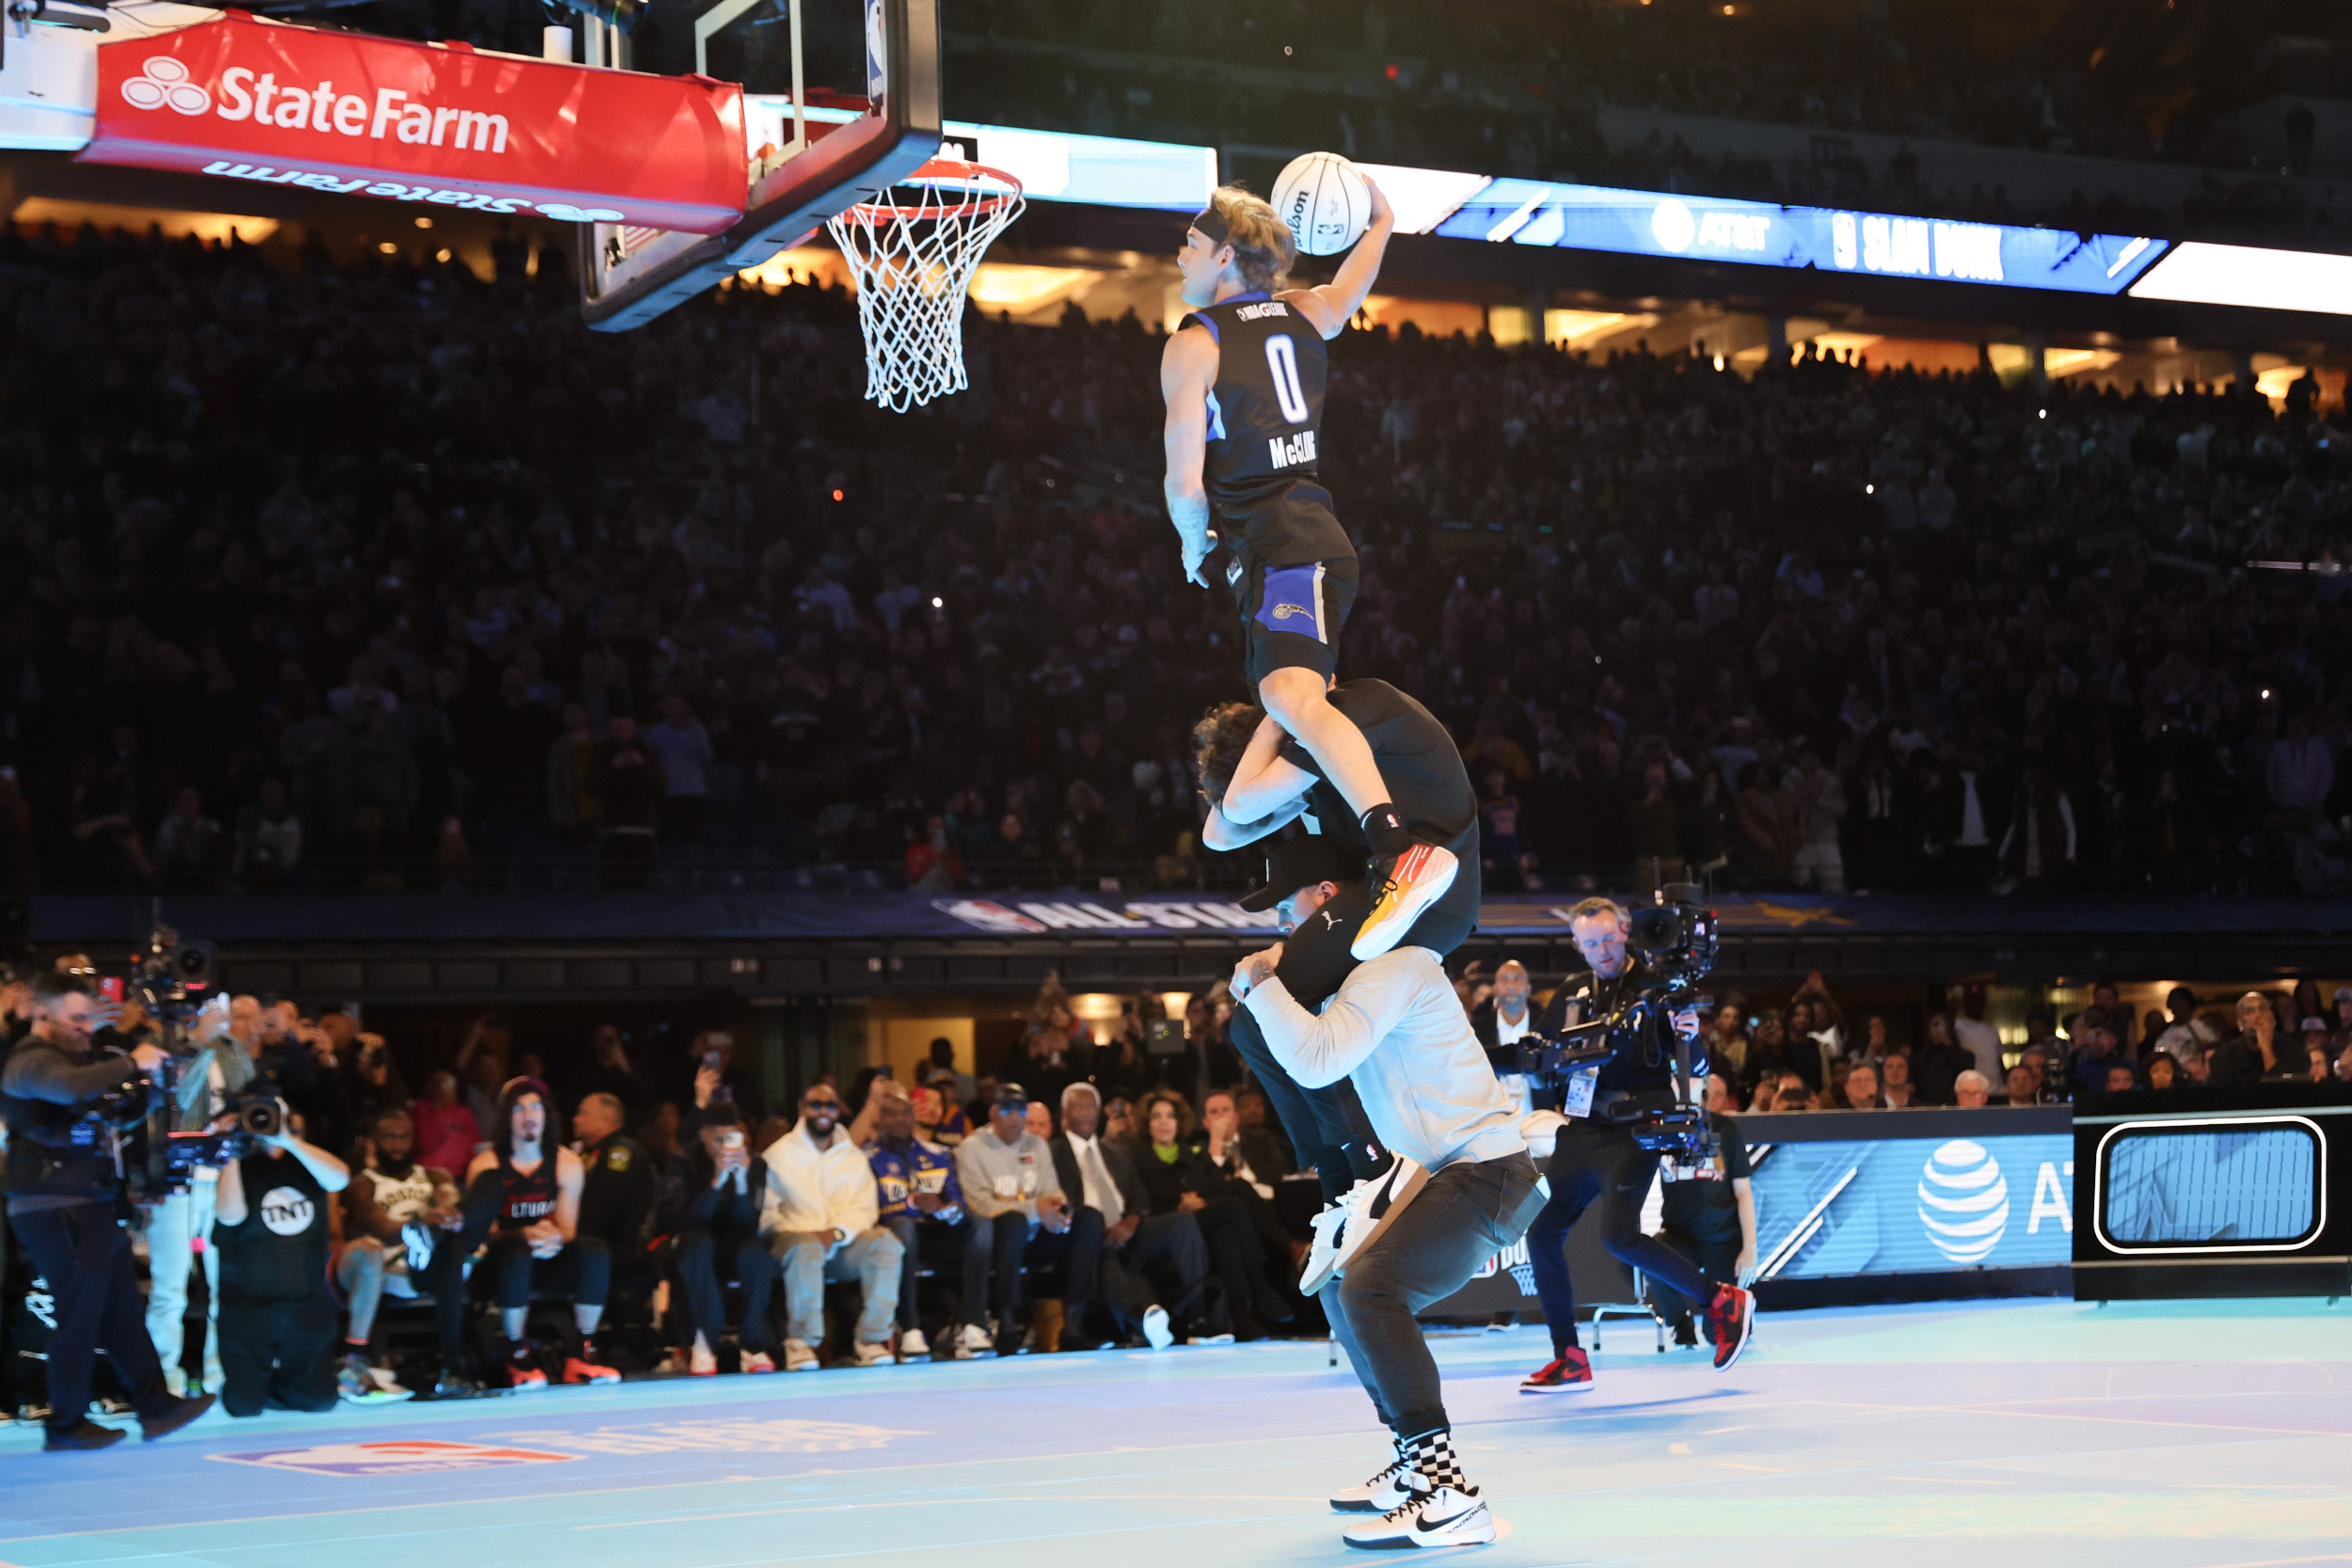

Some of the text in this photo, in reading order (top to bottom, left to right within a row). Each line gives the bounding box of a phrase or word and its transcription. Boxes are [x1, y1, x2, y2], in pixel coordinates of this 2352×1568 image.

[1698, 212, 1771, 251] AT&T
[1863, 215, 1931, 275] SLAM
[1264, 333, 1309, 423] 0
[261, 1199, 311, 1223] TNT
[2026, 1161, 2074, 1235] A
